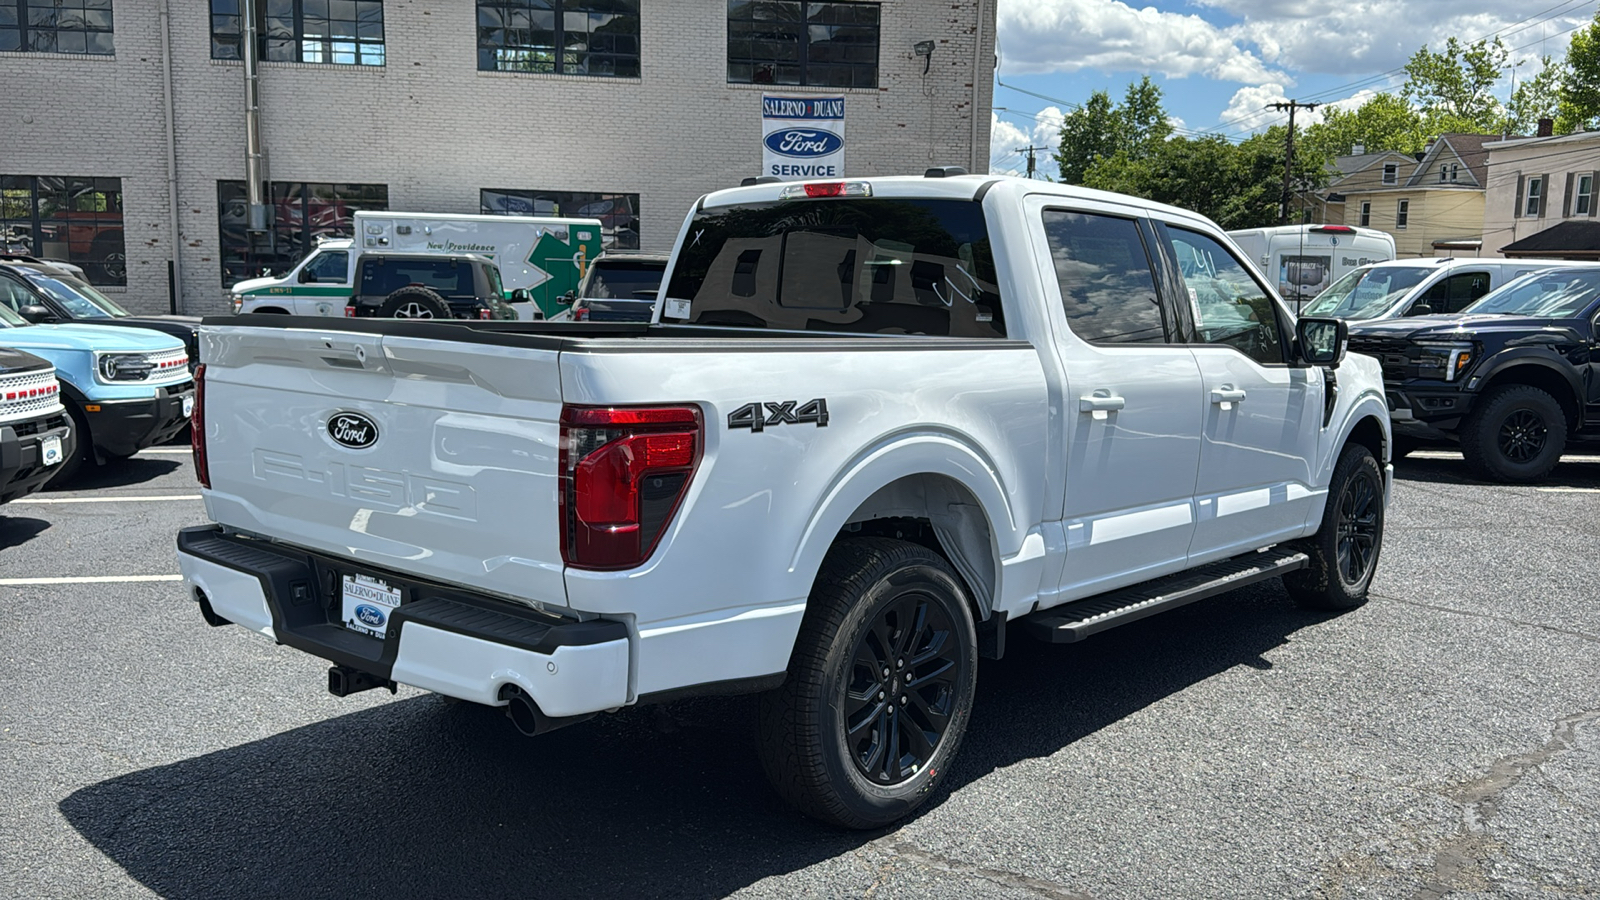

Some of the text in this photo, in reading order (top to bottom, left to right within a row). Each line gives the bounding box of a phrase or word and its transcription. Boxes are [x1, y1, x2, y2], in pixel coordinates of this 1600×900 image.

[764, 99, 843, 117] SALERNO DUANE
[780, 131, 827, 152] Ford
[771, 164, 836, 176] SERVICE
[426, 241, 495, 251] New Providence
[1341, 256, 1357, 266] Bus
[6, 384, 58, 401] BRONCO
[334, 417, 368, 443] Ford
[251, 447, 478, 523] F-150
[344, 582, 400, 606] SALERNO DUANE
[360, 607, 380, 624] Ford
